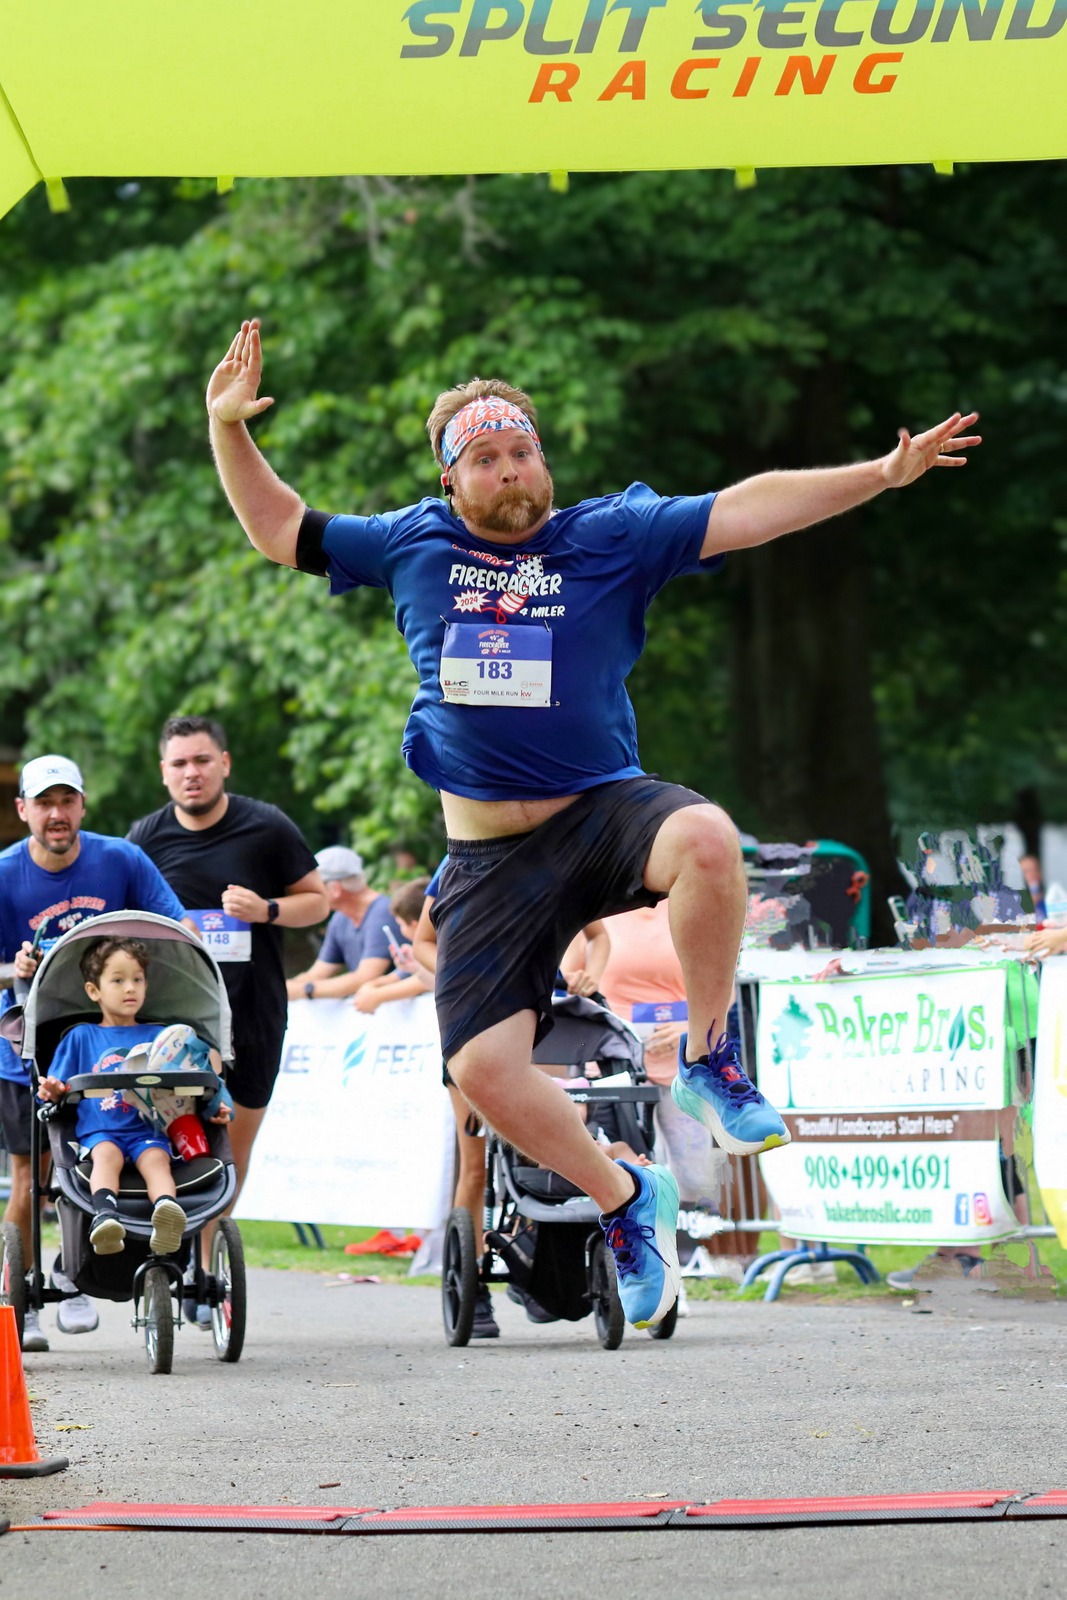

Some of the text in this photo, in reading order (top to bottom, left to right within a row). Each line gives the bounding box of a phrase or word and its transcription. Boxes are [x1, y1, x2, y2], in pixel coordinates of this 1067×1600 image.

[400, 0, 1067, 58] SPLIT SECOND
[528, 52, 904, 103] RACING
[448, 563, 562, 597] FIRECRACKER
[460, 595, 479, 607] 2024
[519, 605, 565, 618] 4 MILER
[476, 660, 513, 679] 183
[520, 689, 532, 698] kw
